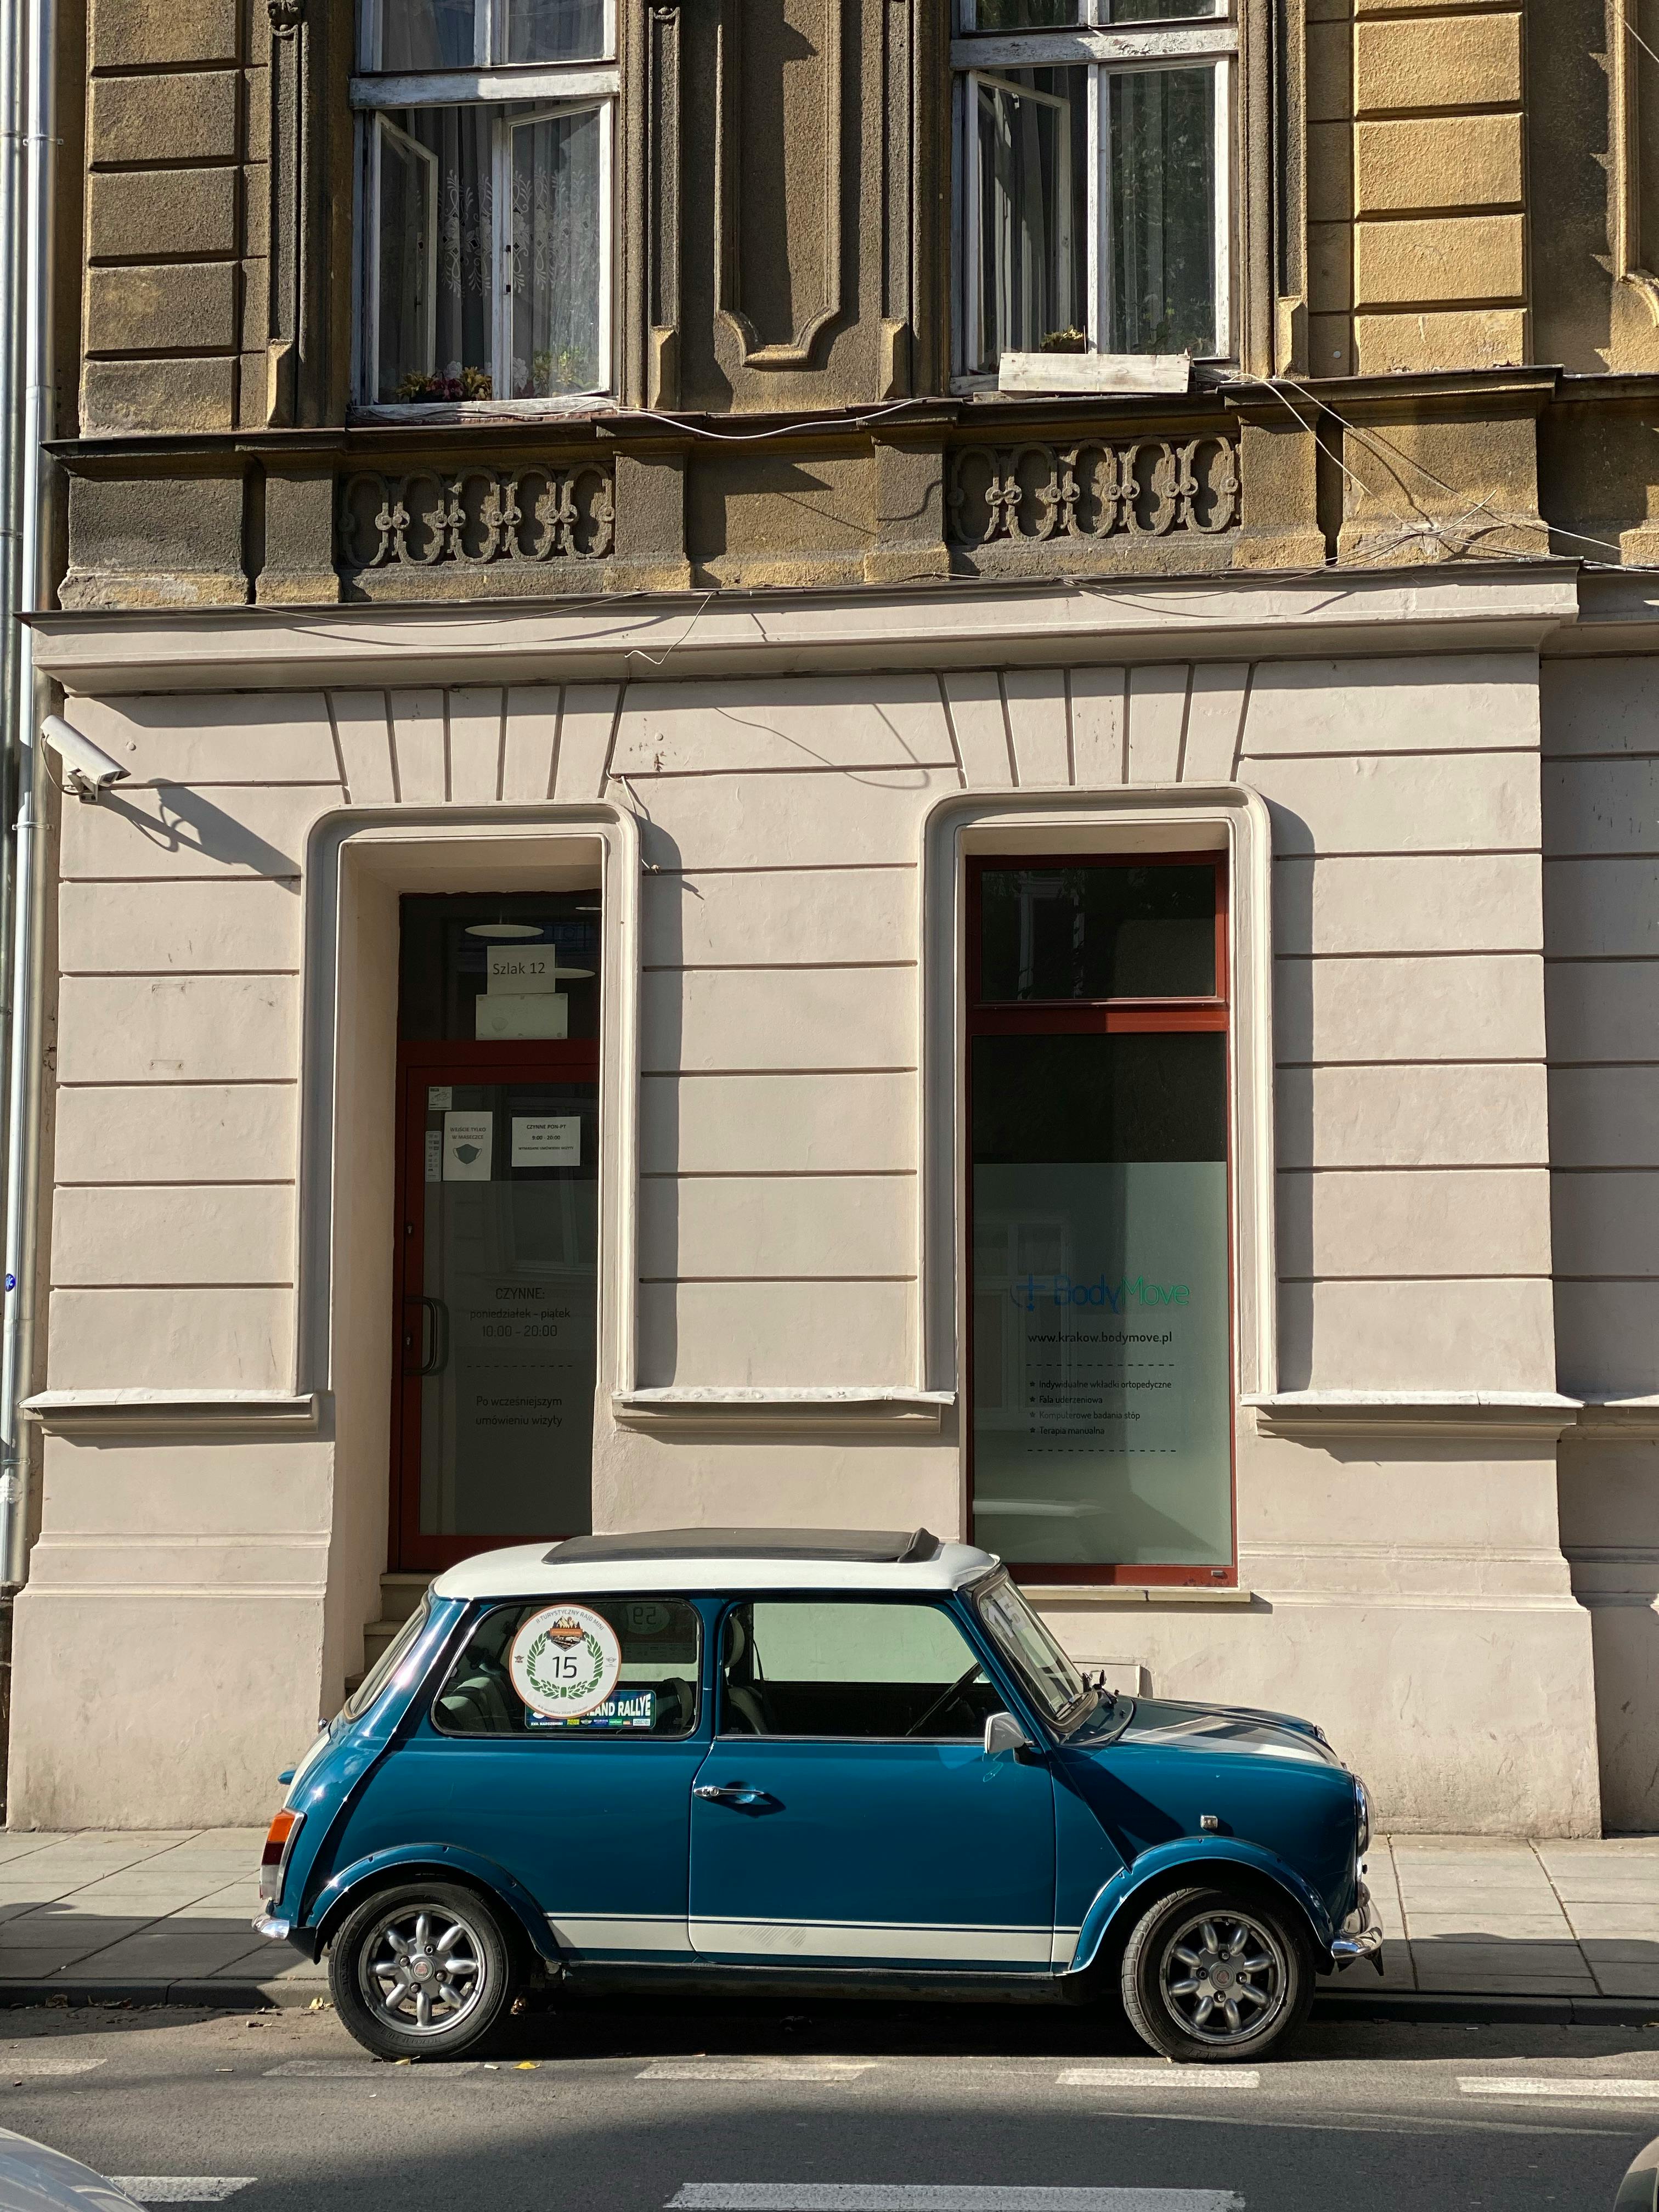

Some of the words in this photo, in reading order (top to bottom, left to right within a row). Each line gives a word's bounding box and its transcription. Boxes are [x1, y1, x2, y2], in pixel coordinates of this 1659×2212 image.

[493, 962, 526, 975] Szlak
[529, 962, 545, 975] 12
[495, 1288, 545, 1300] CZYNNE:
[1053, 1273, 1190, 1315] BodyMove
[470, 1307, 531, 1321] poniedziałek
[540, 1307, 571, 1321] piątek
[482, 1325, 512, 1338] 10:00
[523, 1325, 558, 1338] 20:00
[1028, 1331, 1173, 1345] www.krakow.bodymove.pl
[1039, 1380, 1088, 1390] Indywidualne
[1090, 1380, 1120, 1389] wkładki
[1121, 1380, 1172, 1391] ortopedyczne
[476, 1396, 489, 1406] Po
[490, 1396, 562, 1409] wcześniejszym
[1039, 1395, 1054, 1404] Fala
[1055, 1396, 1103, 1404] uderzeniowa
[475, 1415, 529, 1425] umówieniu
[531, 1415, 562, 1427] wizyty
[1039, 1411, 1092, 1421] Komputerowe
[1093, 1411, 1122, 1420] badania
[1124, 1412, 1141, 1421] stóp
[1040, 1426, 1066, 1437] Terapia
[1068, 1426, 1105, 1435] manualna
[540, 1609, 579, 1621] TURYSTYCZNY
[580, 1612, 593, 1622] RAJD
[592, 1618, 605, 1630] MINI
[552, 1656, 578, 1679] 15
[617, 1693, 651, 1717] RALLYE
